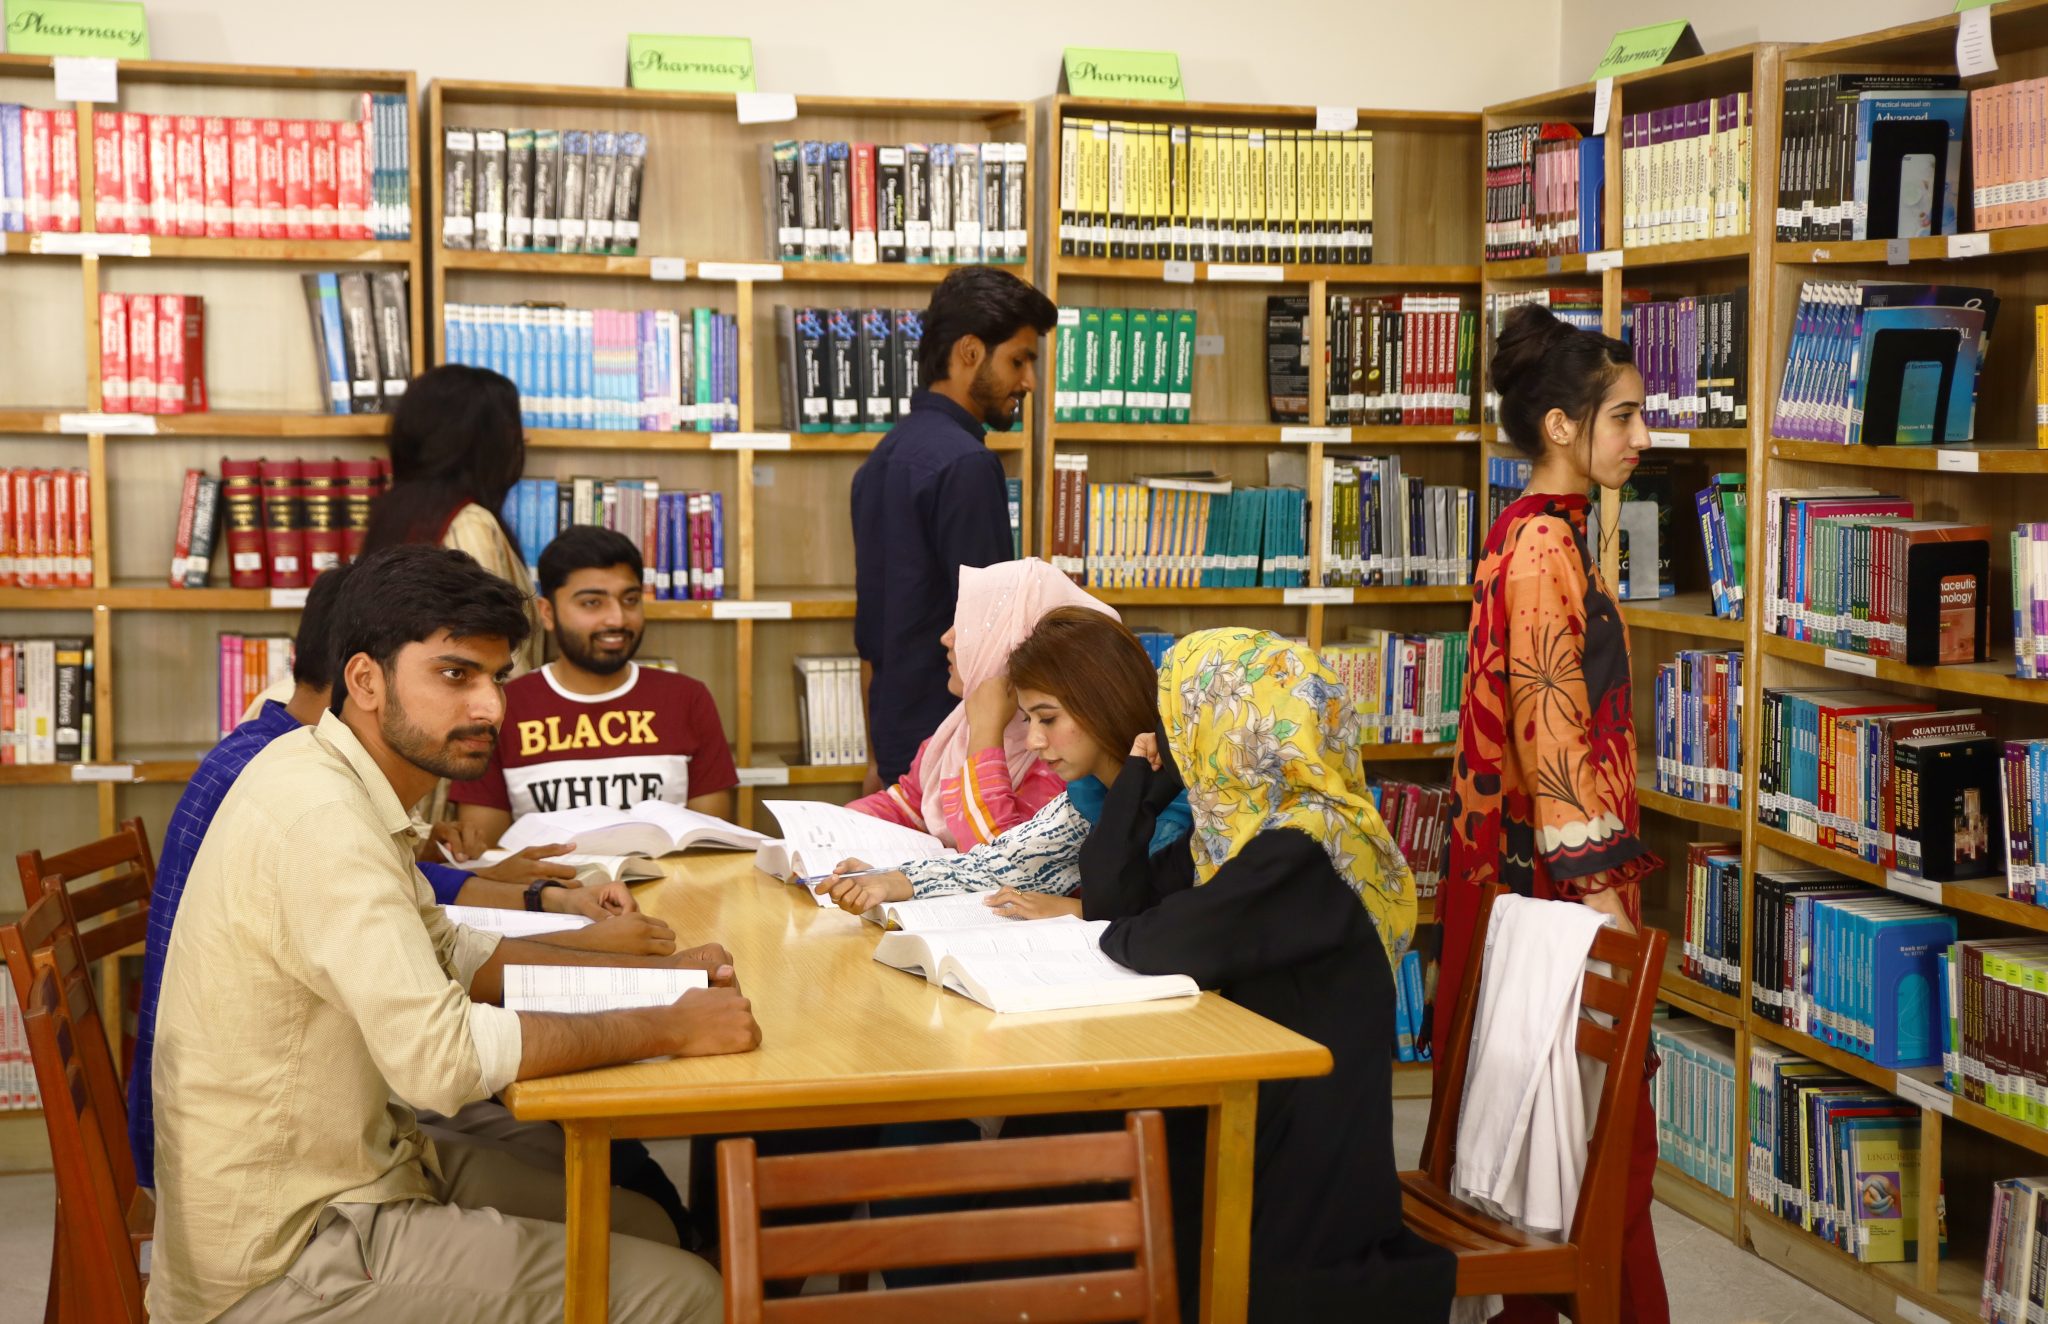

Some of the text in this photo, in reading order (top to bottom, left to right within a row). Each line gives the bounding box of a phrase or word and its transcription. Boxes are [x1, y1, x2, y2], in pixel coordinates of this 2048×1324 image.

[7, 10, 142, 47] Pharmacy
[634, 49, 752, 80] Pharmacy
[1070, 61, 1179, 89] Pharmacy
[1600, 46, 1672, 67] Pharmacy
[1875, 101, 1900, 109] Practical
[1062, 328, 1072, 383] Biochemistry
[1085, 331, 1094, 385] Biochemistry
[1108, 331, 1118, 385] Biochemistry
[1131, 331, 1142, 385] Biochemistry
[1153, 332, 1164, 385] Biochemistry
[1176, 332, 1187, 385] Biochemistry
[1354, 316, 1363, 368] Biochemistry
[1371, 316, 1380, 368] Biochemistry
[1405, 313, 1413, 374] BIOCHEMISTRY
[1416, 313, 1424, 374] BIOCHEMISTRY
[1427, 313, 1435, 374] BIOCHEMISTRY
[1438, 313, 1447, 374] BIOCHEMISTRY
[1448, 313, 1457, 374] BIOCHEMISTRY
[1702, 513, 1713, 571] Pharmacology
[59, 667, 76, 726] Windows
[517, 710, 659, 756] BLACK
[1912, 723, 1976, 736] QUANTITATIVE
[528, 773, 663, 813] WHITE
[1906, 808, 1914, 830] Drugs
[1808, 1148, 1816, 1202] PAKISTAN
[2033, 1231, 2041, 1265] General
[2038, 1270, 2046, 1300] English
